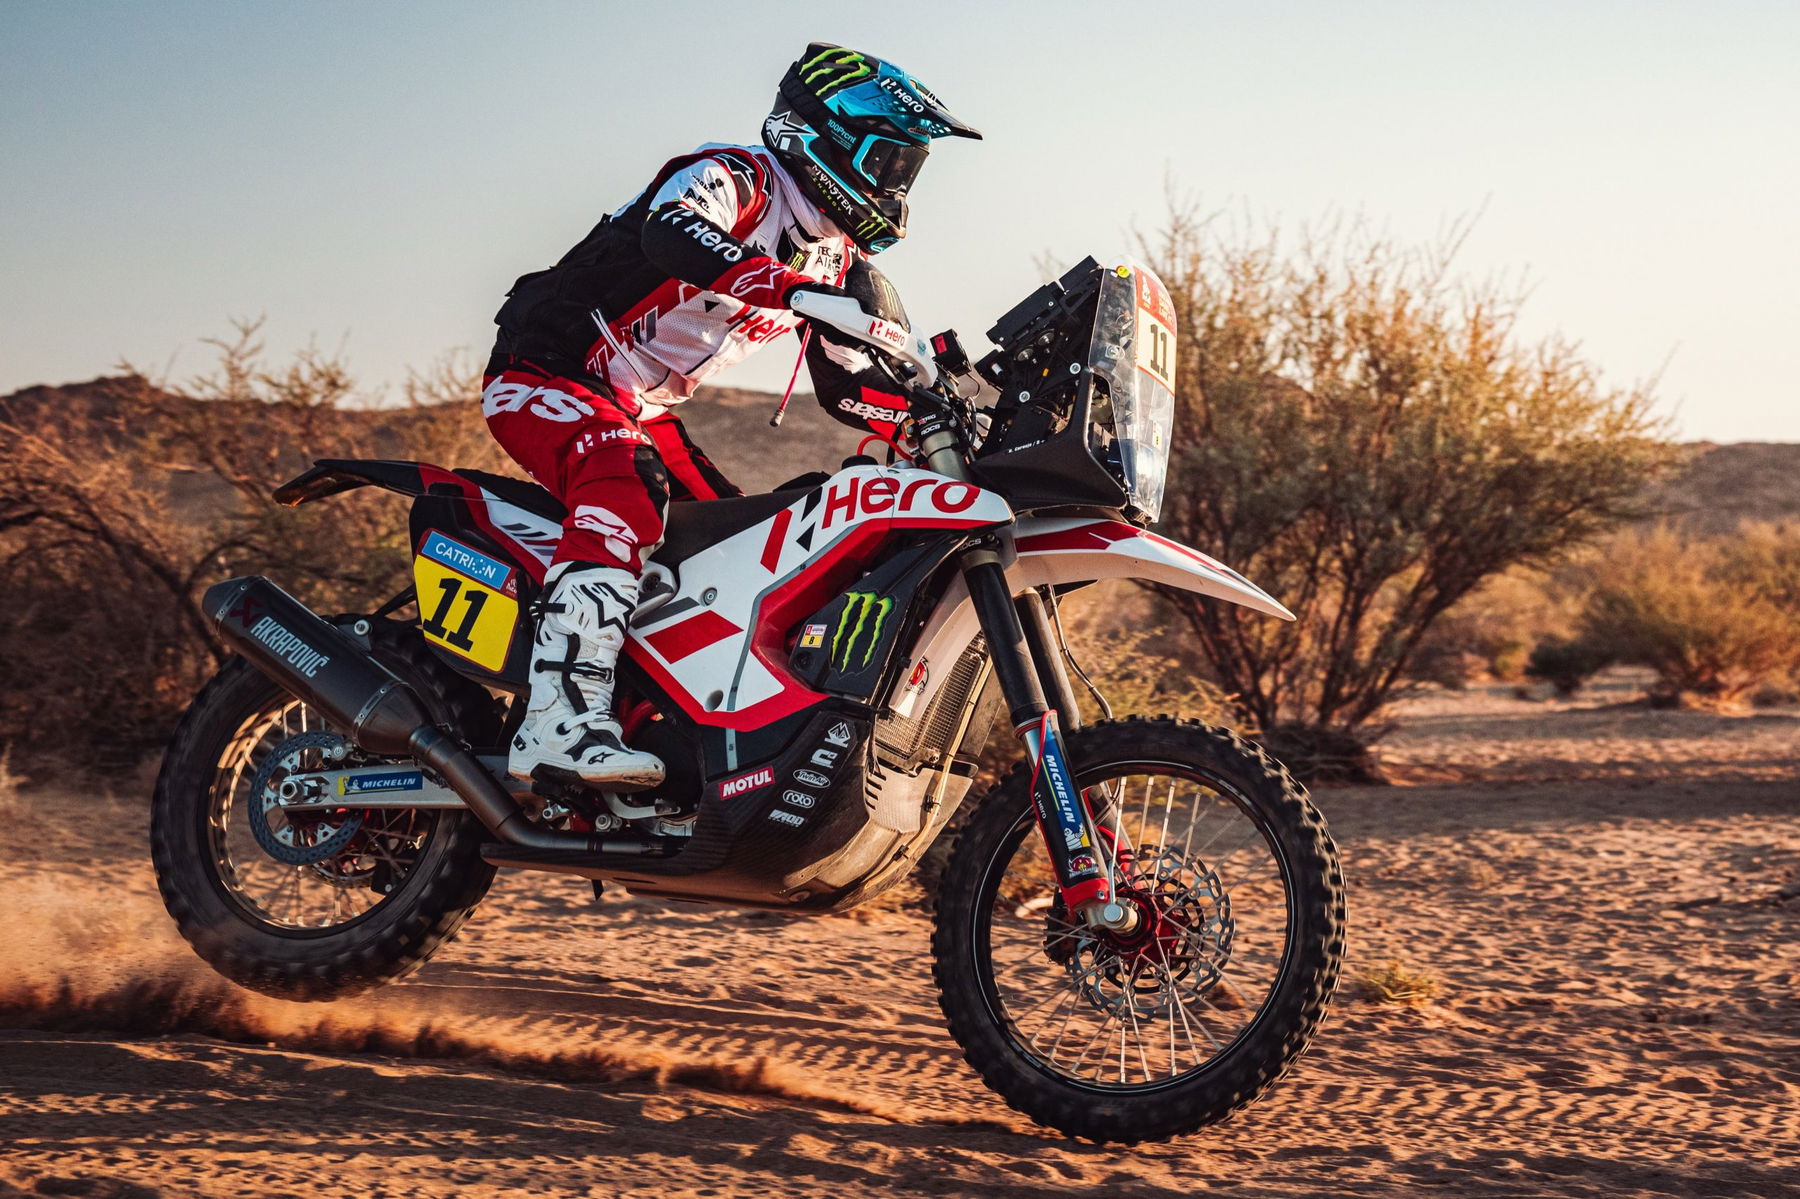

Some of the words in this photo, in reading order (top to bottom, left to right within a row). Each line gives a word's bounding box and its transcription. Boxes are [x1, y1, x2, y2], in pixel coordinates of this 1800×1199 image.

[893, 88, 925, 113] Hero
[811, 164, 854, 216] MONSTER
[683, 221, 743, 262] Hero
[884, 327, 906, 347] Hero
[1150, 323, 1169, 382] 11
[600, 427, 653, 446] Hero
[821, 476, 982, 530] Hero
[422, 577, 490, 653] 11
[362, 776, 416, 788] MICHELIN
[722, 769, 773, 797] MOTUL
[786, 791, 812, 806] roto
[1045, 754, 1076, 823] MICHELIN
